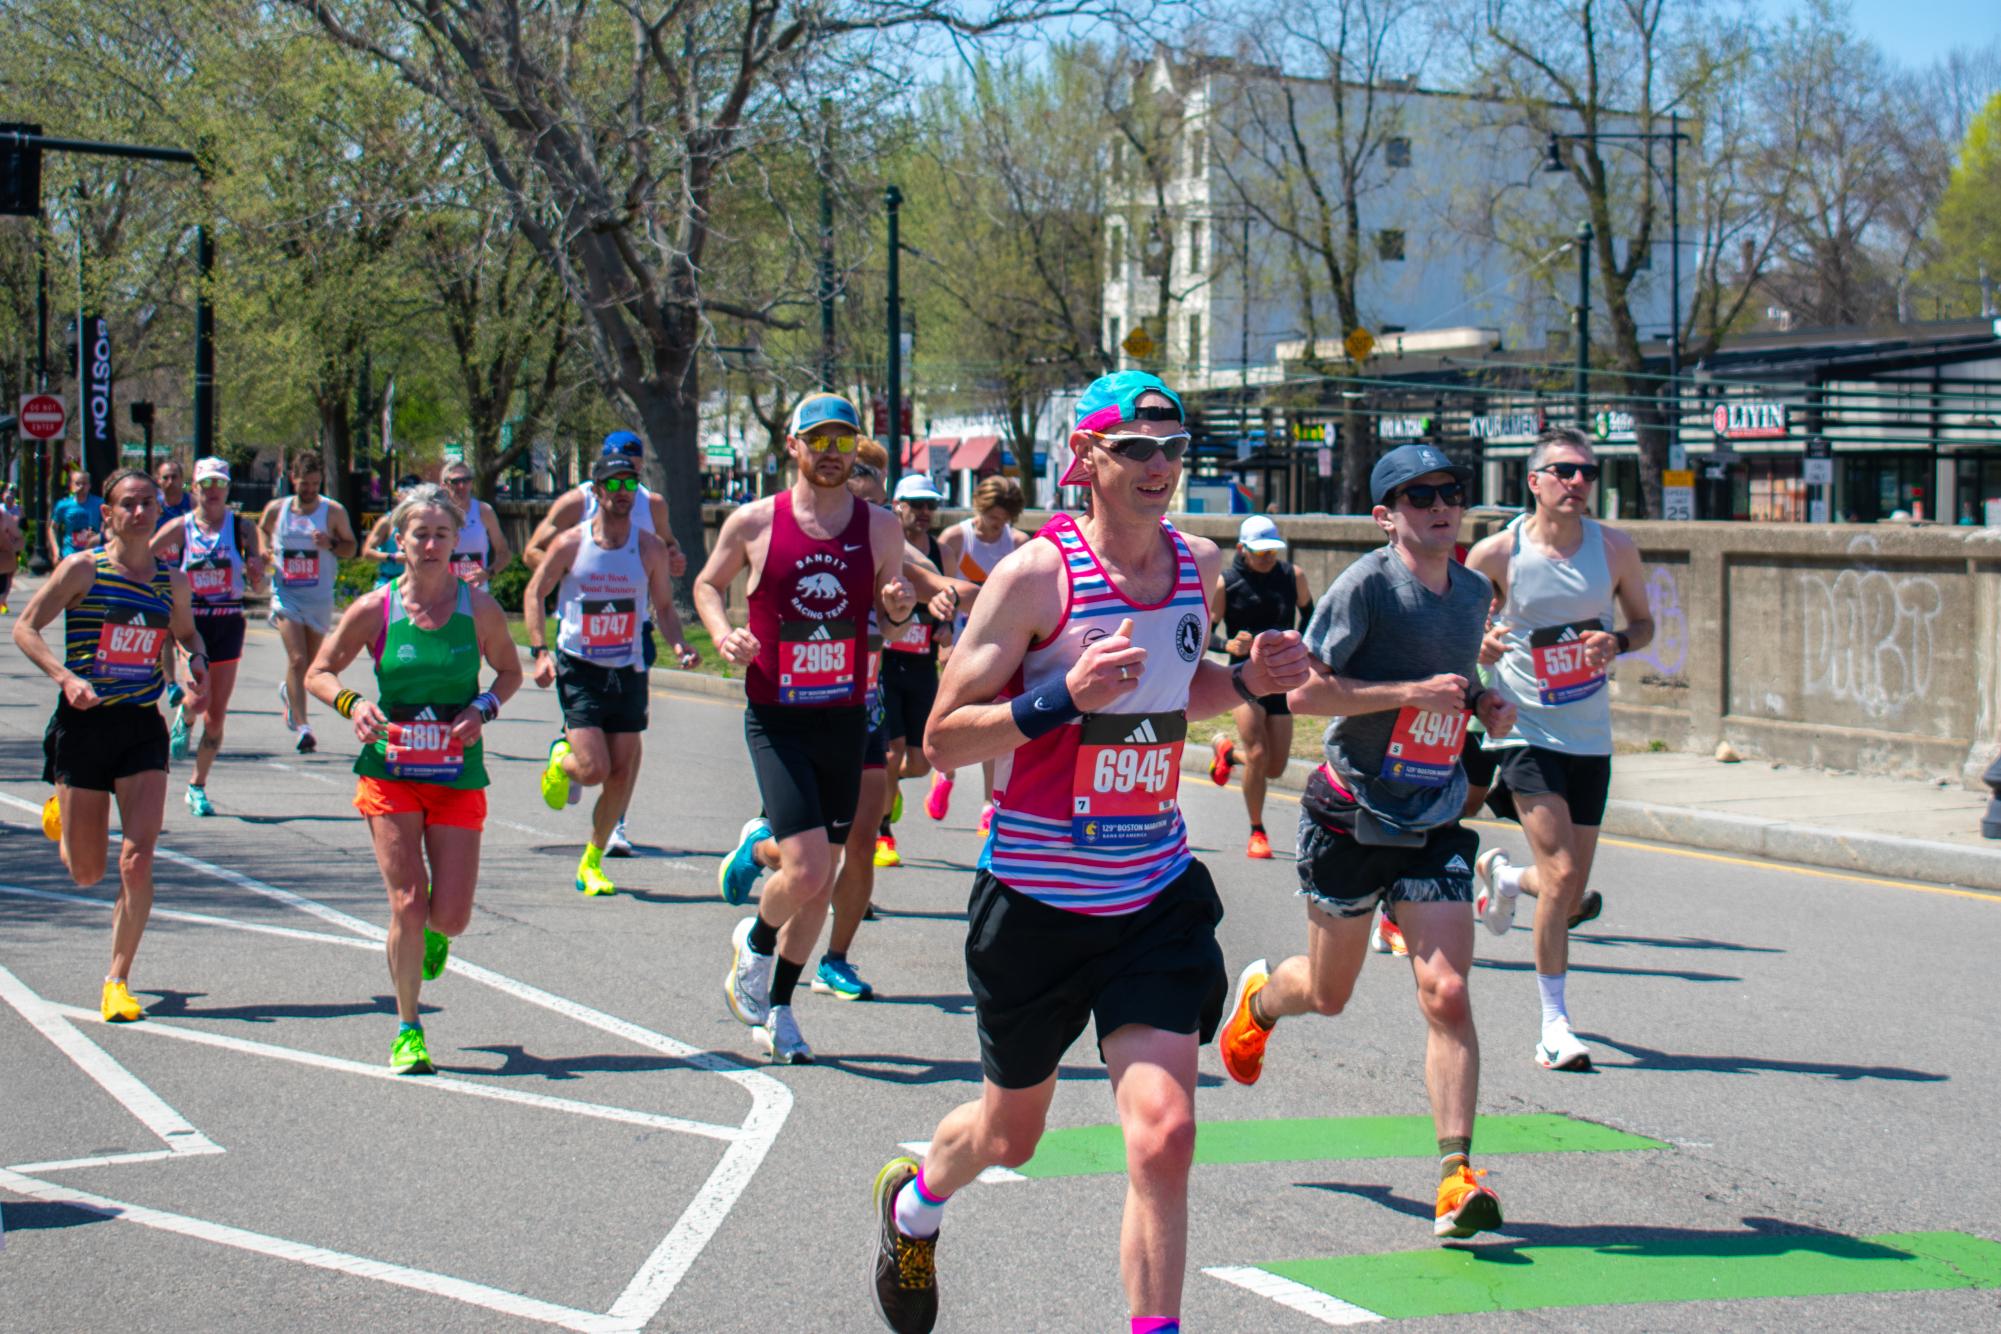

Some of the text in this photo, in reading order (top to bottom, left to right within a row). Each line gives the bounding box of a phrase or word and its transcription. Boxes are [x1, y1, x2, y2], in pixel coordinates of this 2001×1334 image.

[43, 403, 56, 411] NOT
[32, 423, 54, 431] ENTER
[1667, 506, 1689, 520] 25
[796, 553, 848, 570] BANDIT
[791, 597, 849, 620] RACING TEAM
[590, 614, 629, 636] 6747
[110, 626, 157, 654] 6276
[792, 643, 845, 673] 2963
[1544, 643, 1586, 675] 557
[400, 723, 451, 752] 4807
[1408, 710, 1465, 747] 4947
[1093, 747, 1172, 793] 6945
[1078, 800, 1086, 810] 7
[1117, 823, 1143, 832] BOSTON
